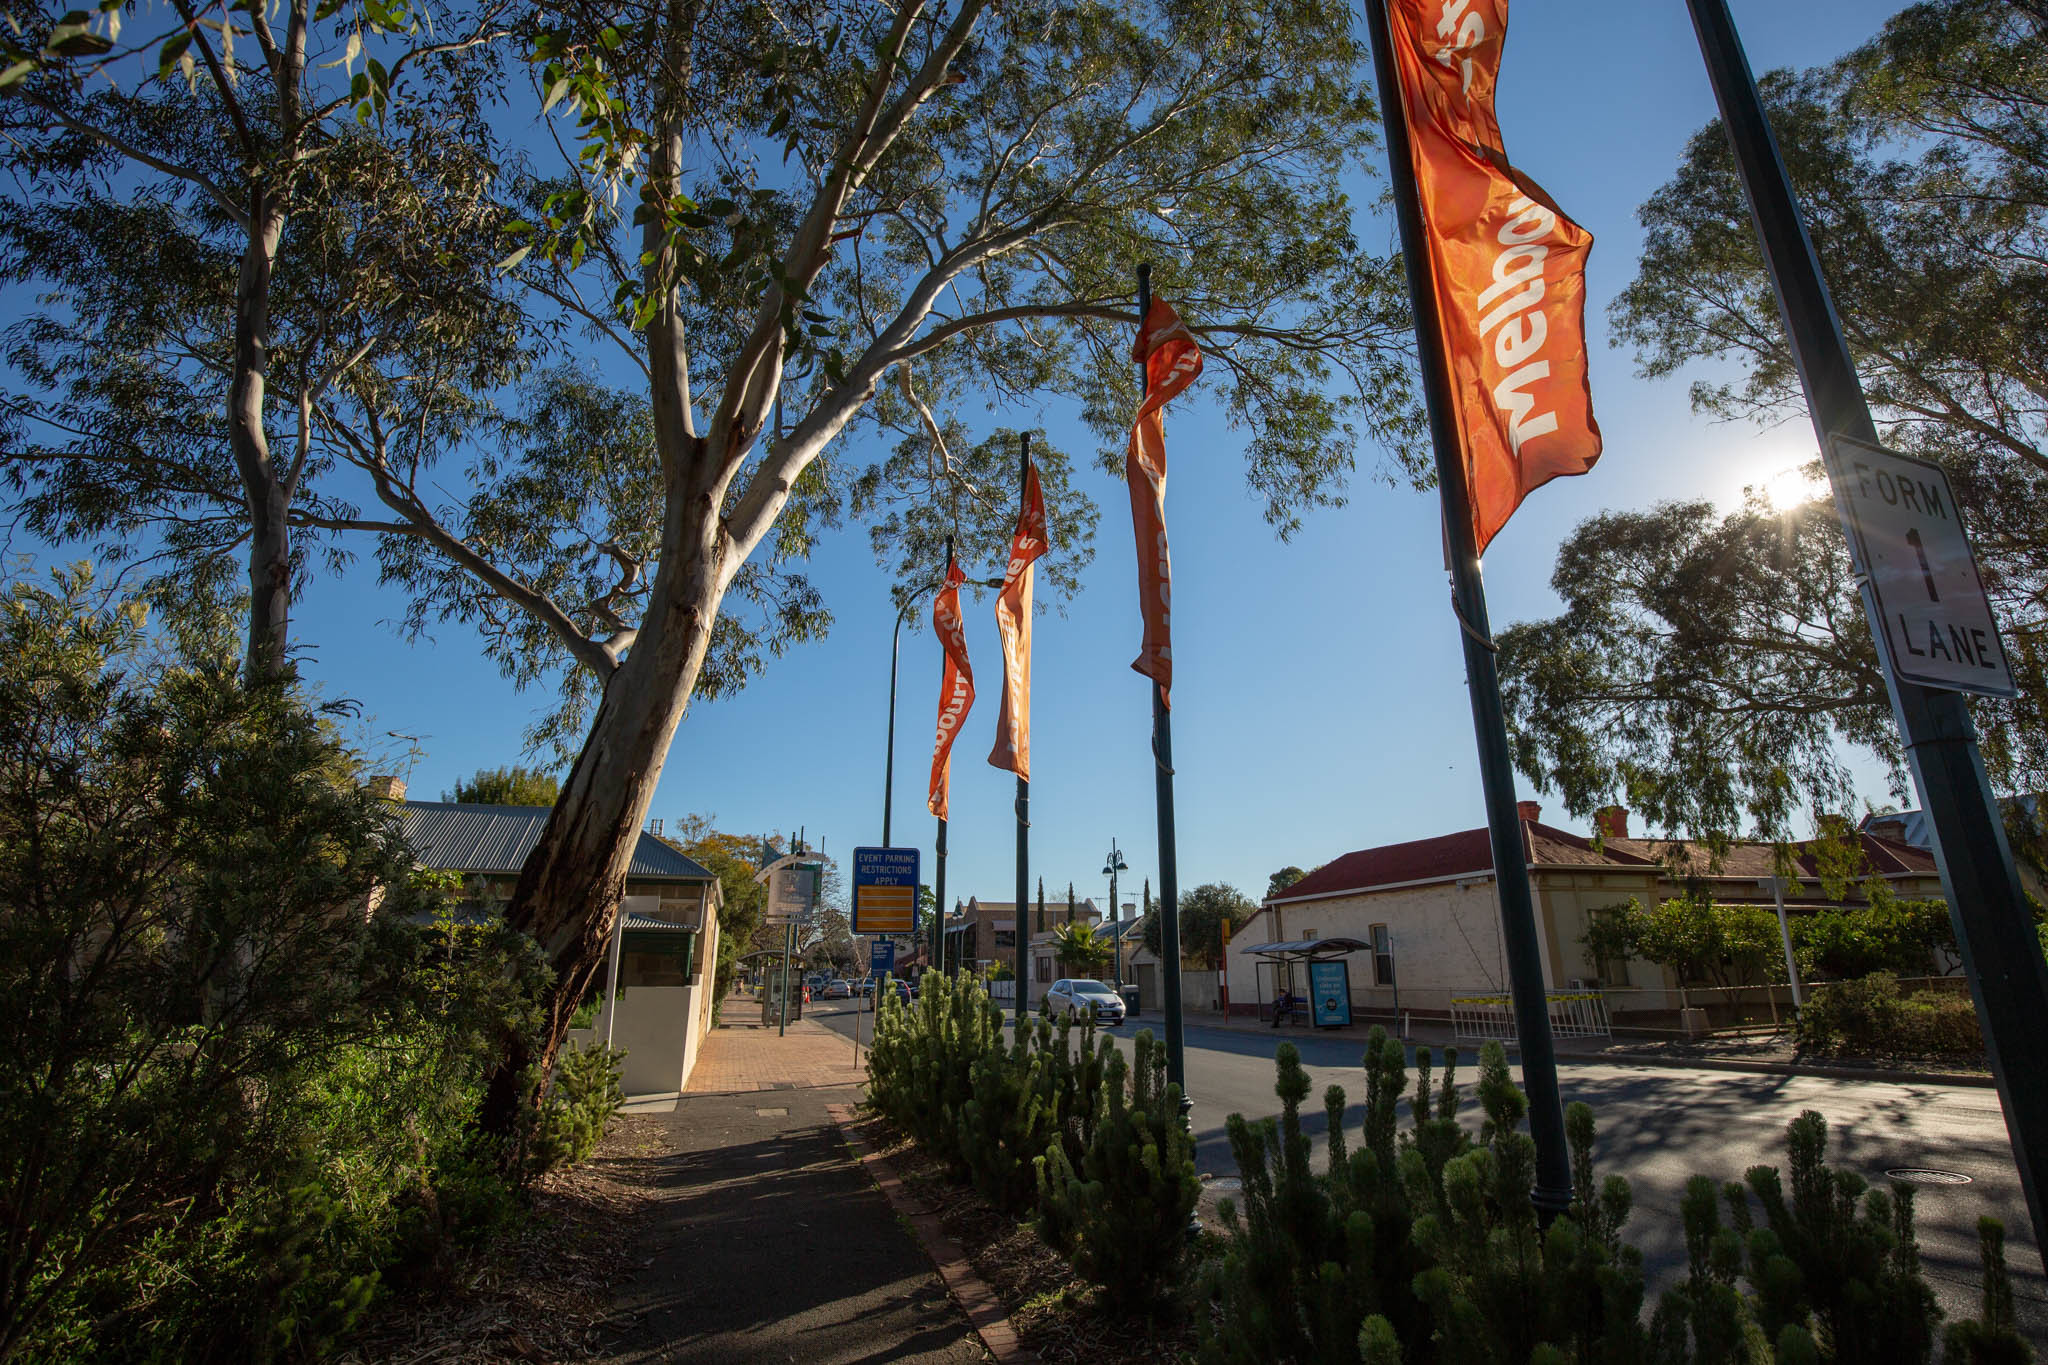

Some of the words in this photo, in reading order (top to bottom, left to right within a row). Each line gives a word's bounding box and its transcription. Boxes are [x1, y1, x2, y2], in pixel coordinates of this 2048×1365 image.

[1477, 184, 1559, 456] Melbo
[1853, 462, 1948, 520] FORM
[1905, 527, 1940, 602] 1
[1899, 613, 1996, 669] LANE
[858, 854, 882, 863] EVENT
[885, 854, 915, 863] PARKING
[861, 865, 912, 874] RESTRICTIONS
[874, 877, 899, 885] APPLY
